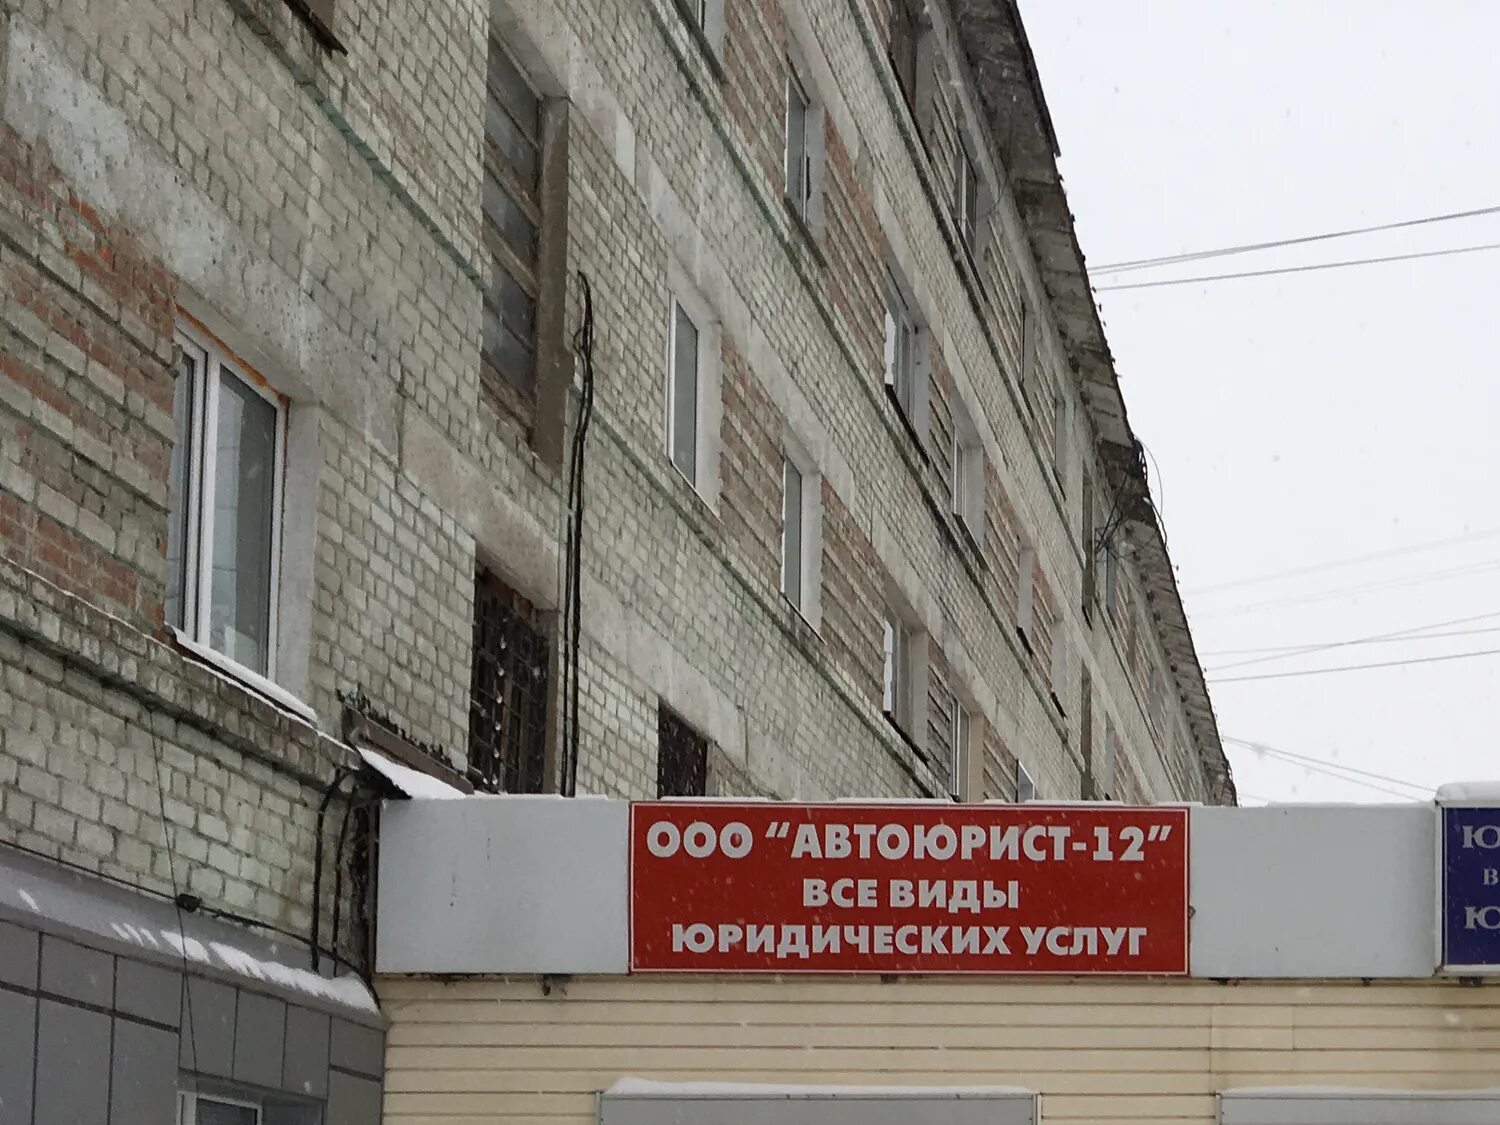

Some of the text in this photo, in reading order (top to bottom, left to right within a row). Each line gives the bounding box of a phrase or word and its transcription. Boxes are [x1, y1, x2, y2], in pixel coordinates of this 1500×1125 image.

[646, 820, 753, 859] ООО
[803, 878, 1019, 914] ВСЕ ВИДЫ
[672, 923, 1147, 959] ЮРИДИЧЕСКИХ УСЛУГ
